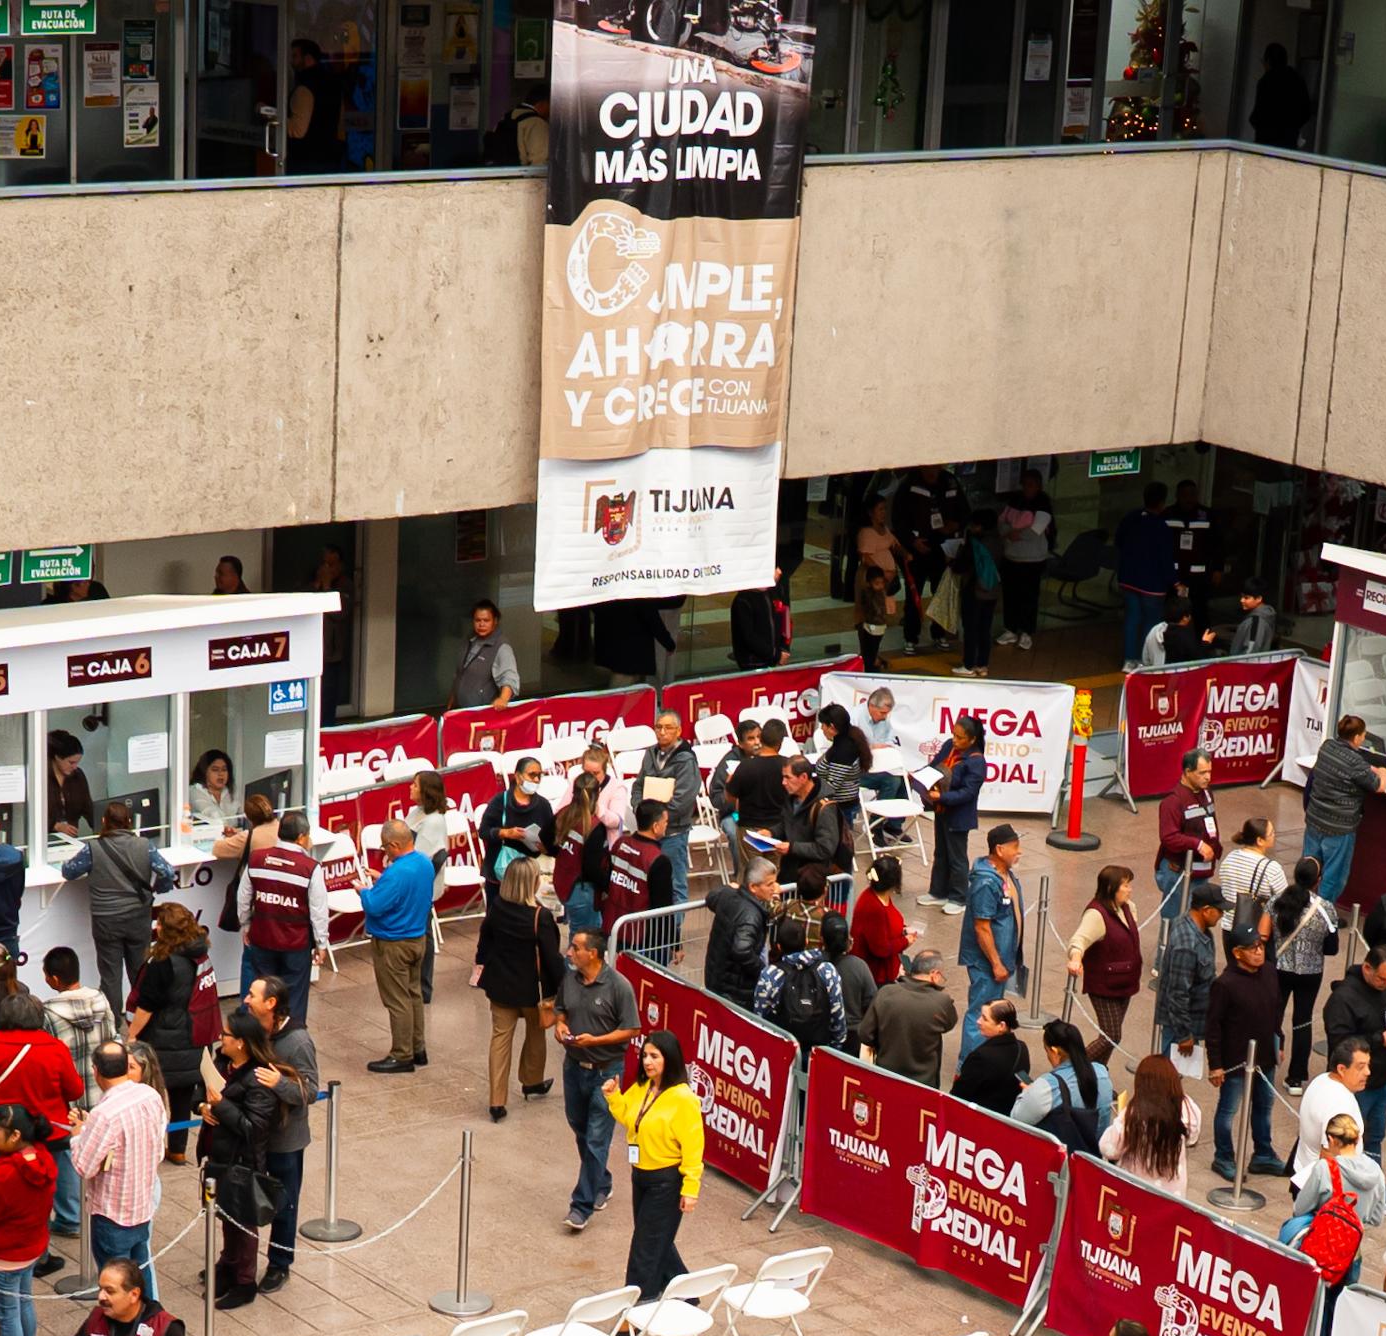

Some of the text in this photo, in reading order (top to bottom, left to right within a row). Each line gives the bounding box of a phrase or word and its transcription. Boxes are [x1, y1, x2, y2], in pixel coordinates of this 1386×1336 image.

[32, 17, 85, 30] EVACUACIÓN
[41, 9, 76, 20] RUTA DE
[668, 59, 717, 84] UNA
[599, 90, 763, 139] CIUDAD
[595, 140, 760, 184] MÁS LIMPIA
[709, 379, 750, 396] CON
[564, 378, 704, 427] Y CRECE
[706, 397, 767, 415] TIJUANA
[650, 487, 734, 513] TIJUANA
[31, 566, 81, 578] EVACUACIÓN
[40, 558, 72, 568] RUTA DE
[592, 568, 689, 588] RESPONSABILIDAD
[227, 641, 270, 661] CAJA
[274, 638, 287, 659] 7
[87, 658, 130, 679] CAJA
[135, 652, 149, 675] 6
[1207, 682, 1279, 714] MEGA
[1138, 722, 1183, 739] TIJUANA
[1224, 715, 1269, 732] EVENTO
[255, 889, 299, 909] PREDIAL
[697, 1023, 772, 1098] MEGA
[715, 1078, 761, 1120] EVENTO
[829, 1128, 890, 1169] TIJUANA
[925, 1122, 1028, 1206] MEGA
[905, 1163, 1022, 1267] PREDIAL
[948, 1181, 1014, 1227] EVENTO
[952, 1244, 984, 1266] 2026
[1080, 1239, 1142, 1286] TIJUANA
[1176, 1241, 1283, 1331] MEGA
